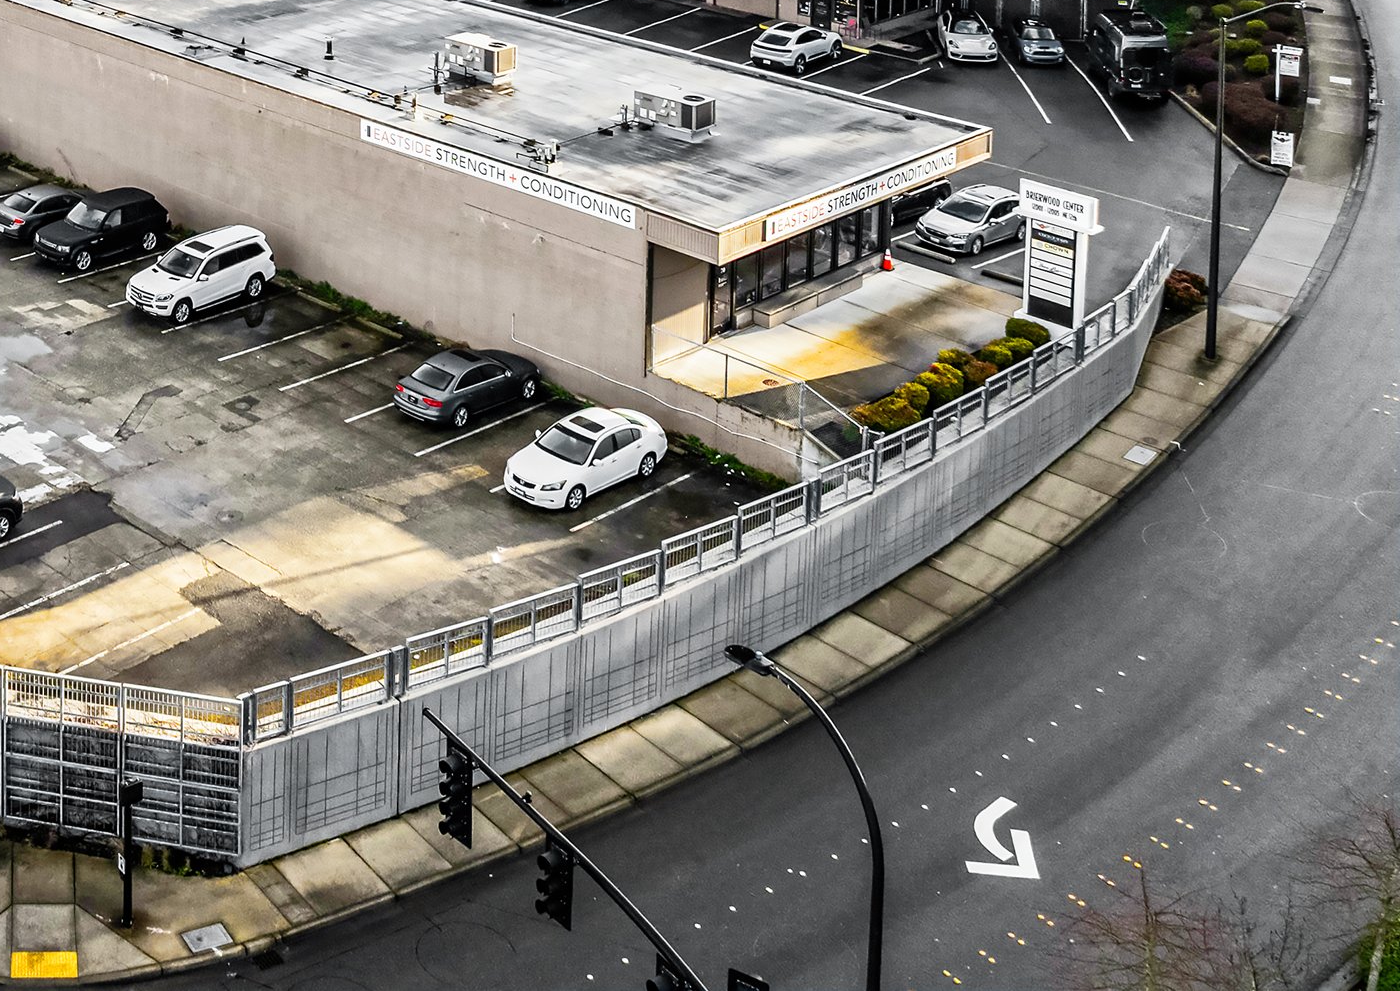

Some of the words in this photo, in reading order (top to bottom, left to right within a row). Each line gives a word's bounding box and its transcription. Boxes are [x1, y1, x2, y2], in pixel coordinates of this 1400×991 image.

[374, 127, 432, 158] EASTSIDE
[436, 147, 506, 182] STRENGTH
[520, 175, 632, 223] CONDITIONING
[777, 202, 825, 232] EASTSIDE
[827, 181, 878, 213] STRENGTH
[887, 152, 955, 189] CONDITIONING
[1026, 190, 1060, 207] BRIERWOOD
[1063, 200, 1084, 214] CENTER
